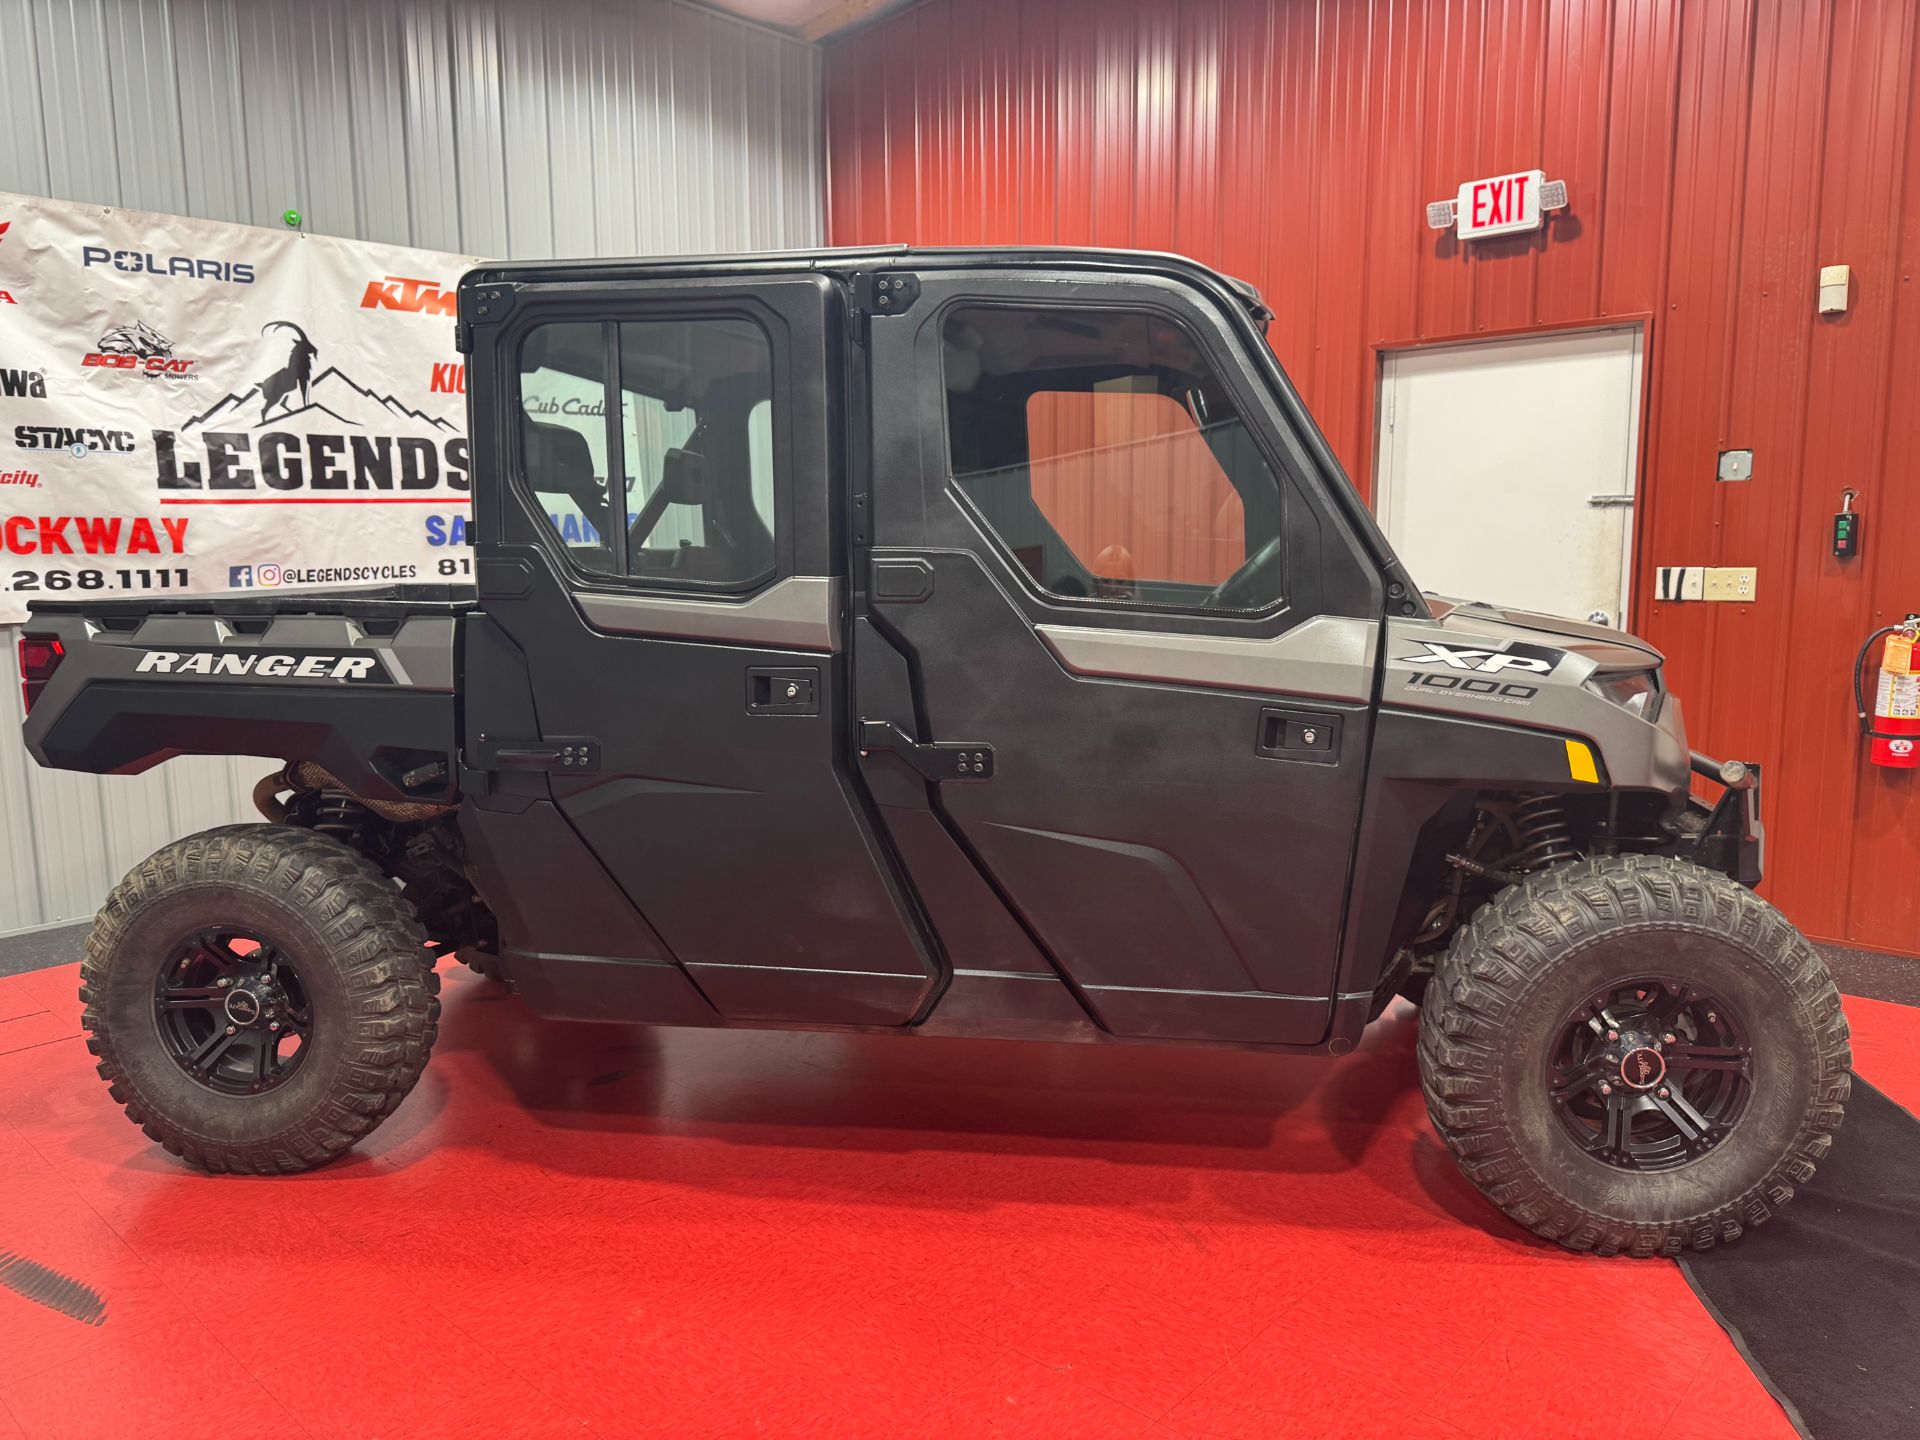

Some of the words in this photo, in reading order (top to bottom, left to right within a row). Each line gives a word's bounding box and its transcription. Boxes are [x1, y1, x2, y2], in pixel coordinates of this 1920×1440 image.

[1471, 176, 1529, 228] EXIT
[83, 246, 255, 284] POLARIS
[360, 276, 458, 316] KTM
[523, 396, 560, 414] Cub
[15, 426, 135, 452] STACYC
[152, 430, 470, 490] LEGENDS
[0, 516, 189, 554] CKWAY
[282, 565, 416, 583] @LEGENDSCYCLES
[135, 651, 376, 679] RANGER
[1400, 643, 1552, 674] XP
[1408, 672, 1538, 699] 1000
